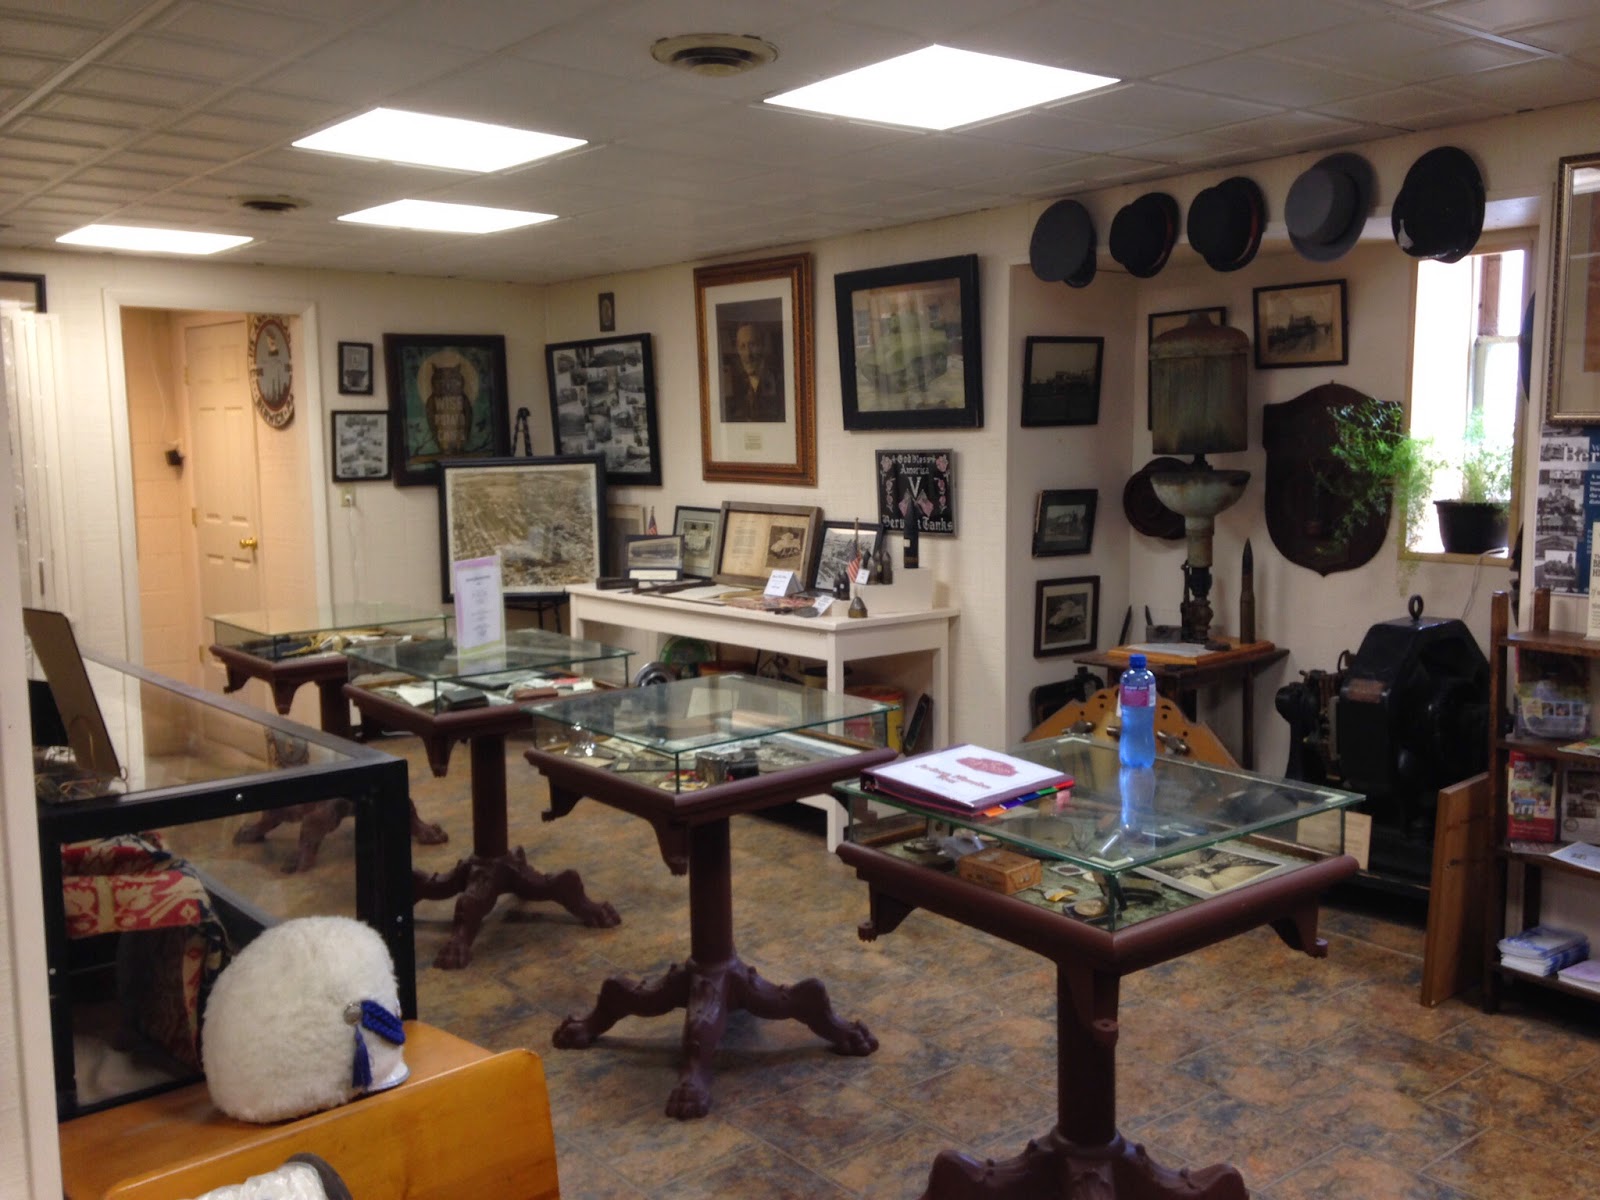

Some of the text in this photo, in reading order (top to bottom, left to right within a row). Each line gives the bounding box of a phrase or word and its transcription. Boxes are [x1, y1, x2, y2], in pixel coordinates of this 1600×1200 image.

[908, 476, 922, 498] V
[882, 514, 953, 531] Berw Tanks
